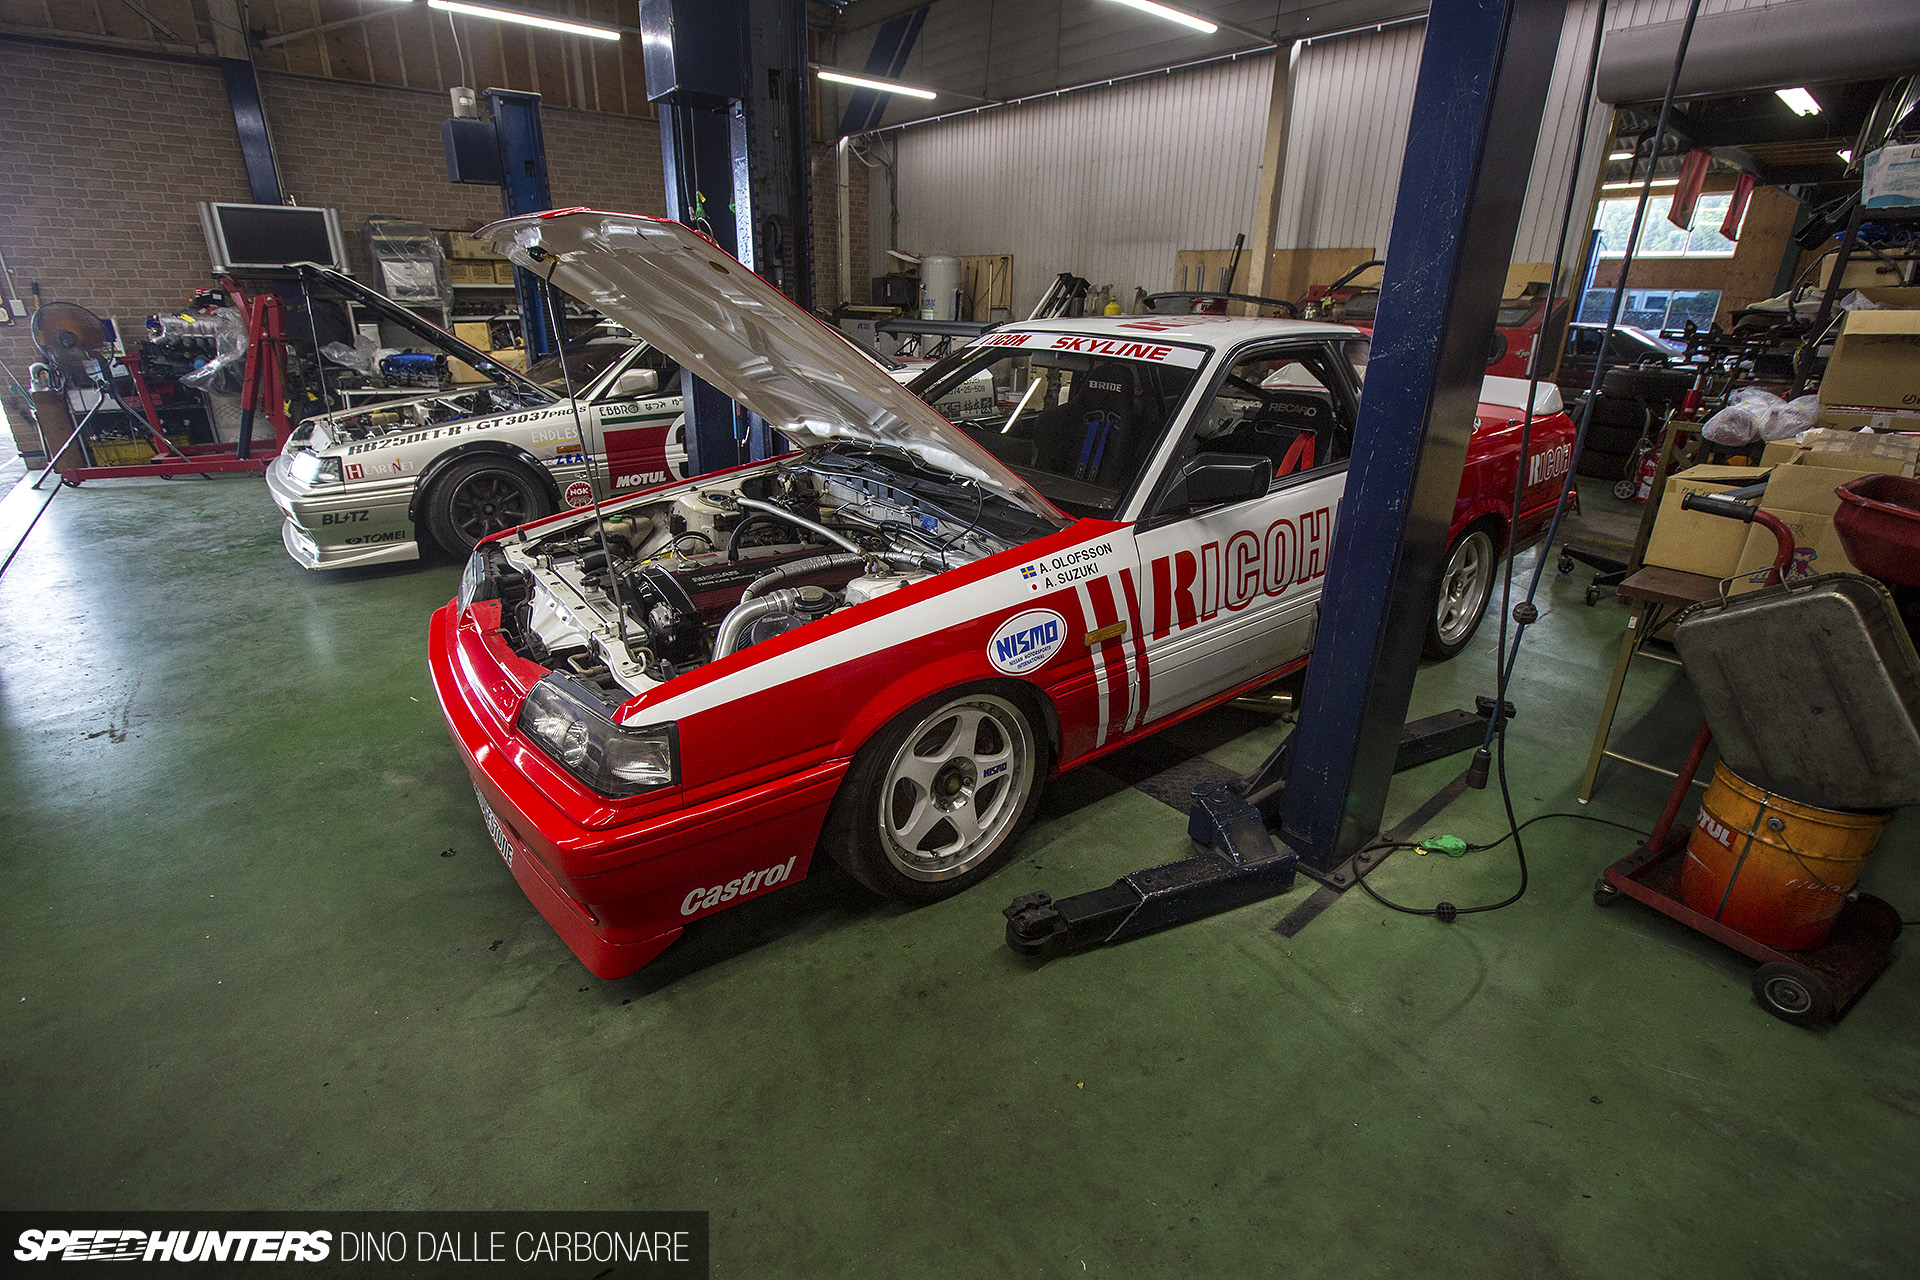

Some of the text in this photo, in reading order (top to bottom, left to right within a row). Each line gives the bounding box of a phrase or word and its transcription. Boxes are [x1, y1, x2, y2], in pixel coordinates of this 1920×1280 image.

[1050, 337, 1172, 361] SKYLINE
[1089, 380, 1122, 393] BRIDE
[599, 403, 639, 417] EBBRO
[1268, 402, 1317, 417] RECARO
[531, 427, 584, 443] ENDLES
[1528, 443, 1571, 487] RICOH
[616, 471, 666, 488] MOTUL
[570, 487, 589, 496] NGK
[322, 510, 369, 525] BLITZ
[363, 530, 405, 544] TOMEI
[1040, 543, 1113, 574] A. OLOFSSON
[1045, 563, 1099, 589] A. SUZUKI
[1151, 506, 1329, 641] RICOH
[996, 620, 1058, 662] NISMO
[1009, 645, 1052, 666] NISSAN MOTORSPORTS
[1017, 654, 1045, 670] INTERNATIONAL
[983, 762, 1007, 778] NISMO
[680, 855, 796, 916] Castrol
